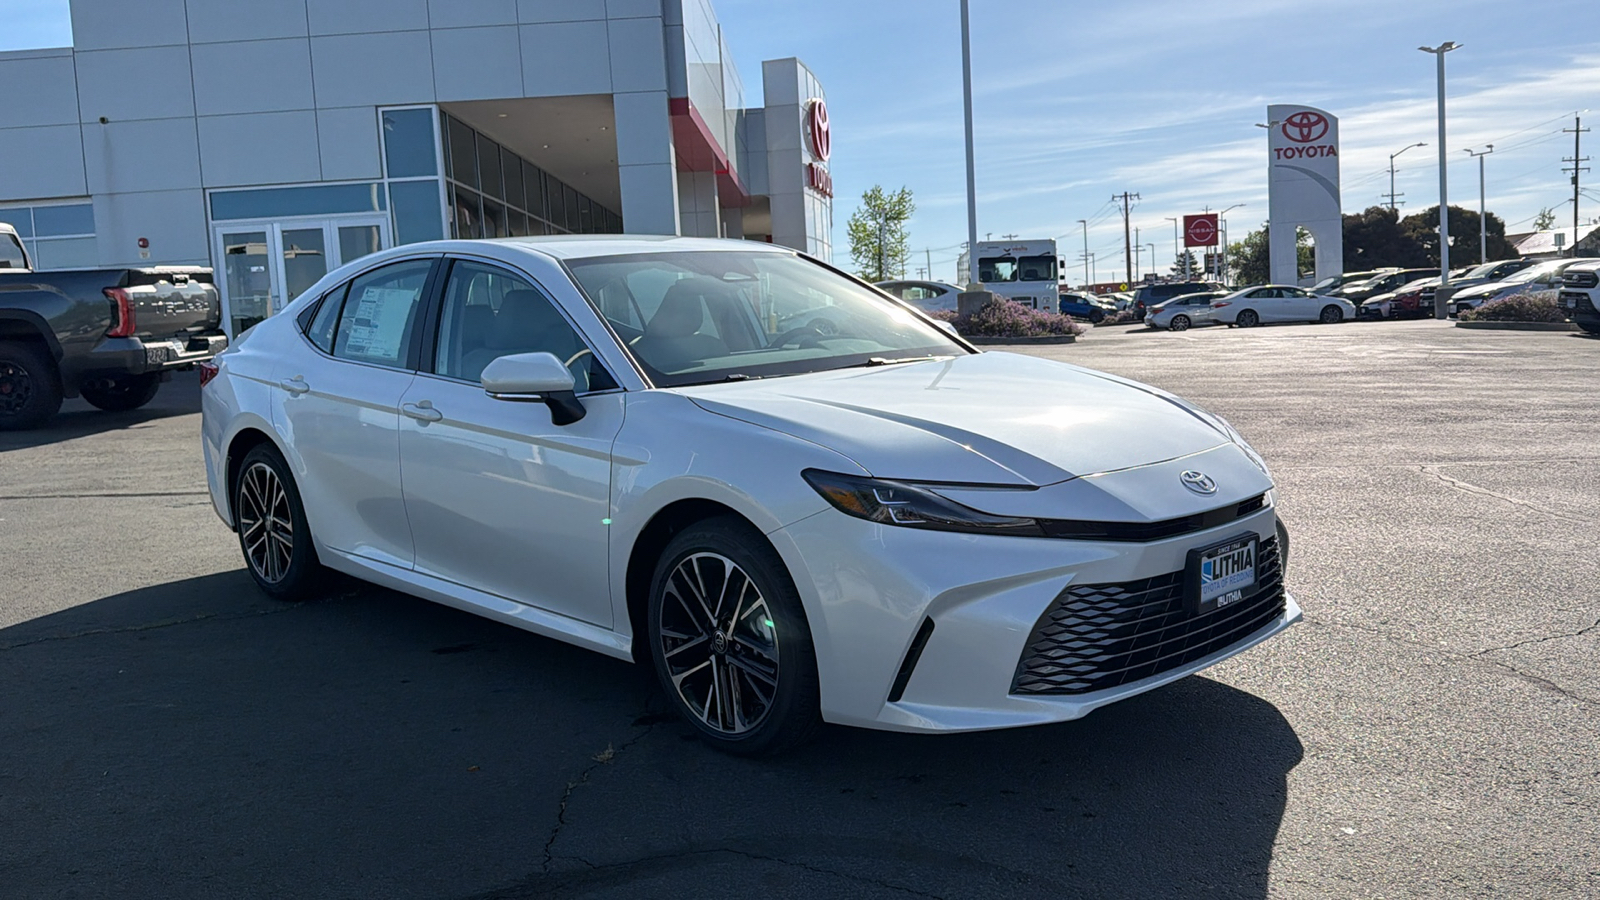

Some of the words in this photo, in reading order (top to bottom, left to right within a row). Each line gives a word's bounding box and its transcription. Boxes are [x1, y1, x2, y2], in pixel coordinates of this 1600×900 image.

[1273, 145, 1337, 160] TOYOTA
[1217, 545, 1230, 554] SINCE
[1213, 547, 1253, 581] LITHIA
[1221, 577, 1228, 587] OF
[1229, 569, 1253, 585] REDDING
[1222, 589, 1242, 605] LITHIA
